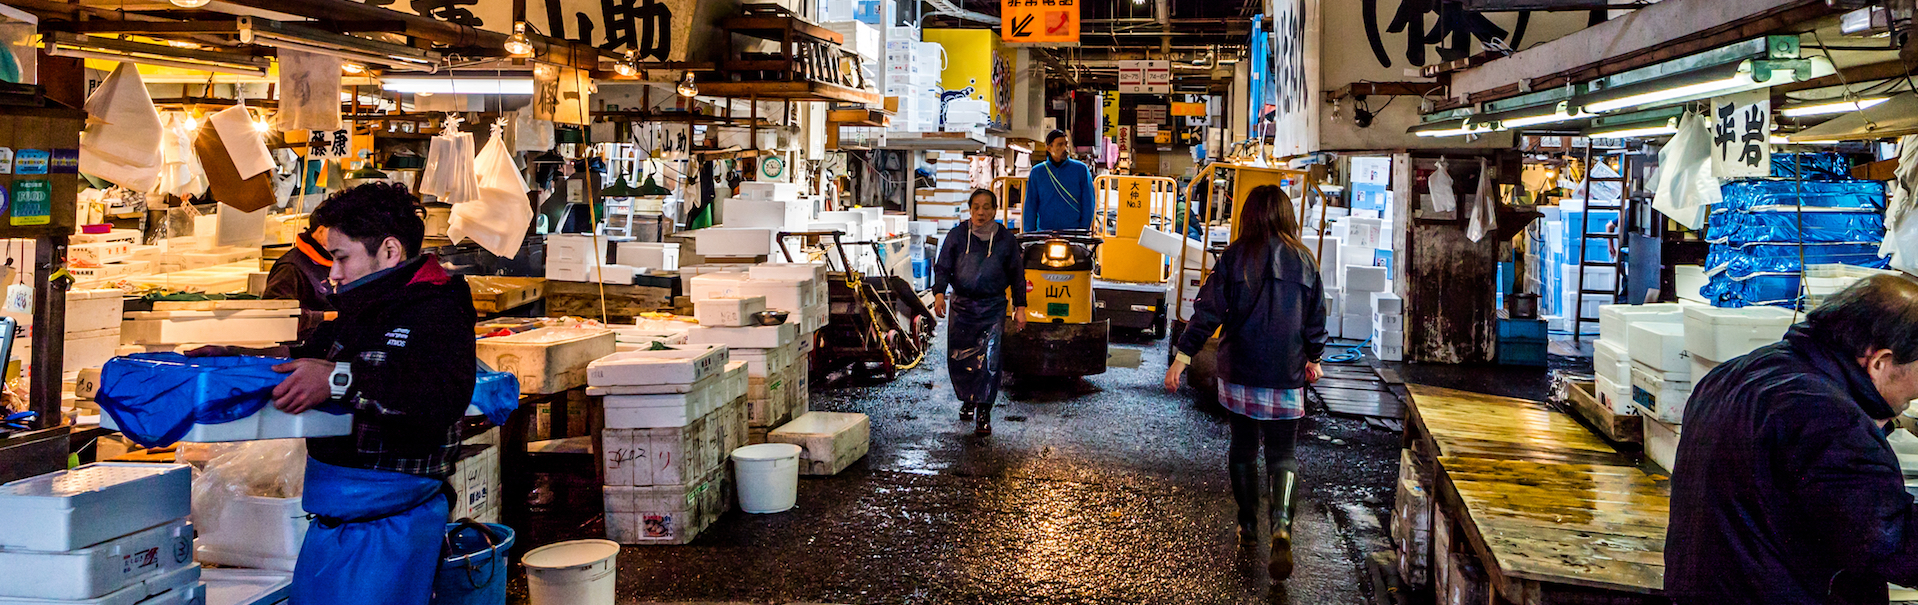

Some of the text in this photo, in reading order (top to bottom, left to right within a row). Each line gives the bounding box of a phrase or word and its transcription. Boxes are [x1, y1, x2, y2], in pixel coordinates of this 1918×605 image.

[1714, 101, 1765, 168] 平岩
[1130, 181, 1140, 200] 大仲
[1126, 200, 1142, 209] No.3
[1045, 285, 1071, 298] 山八
